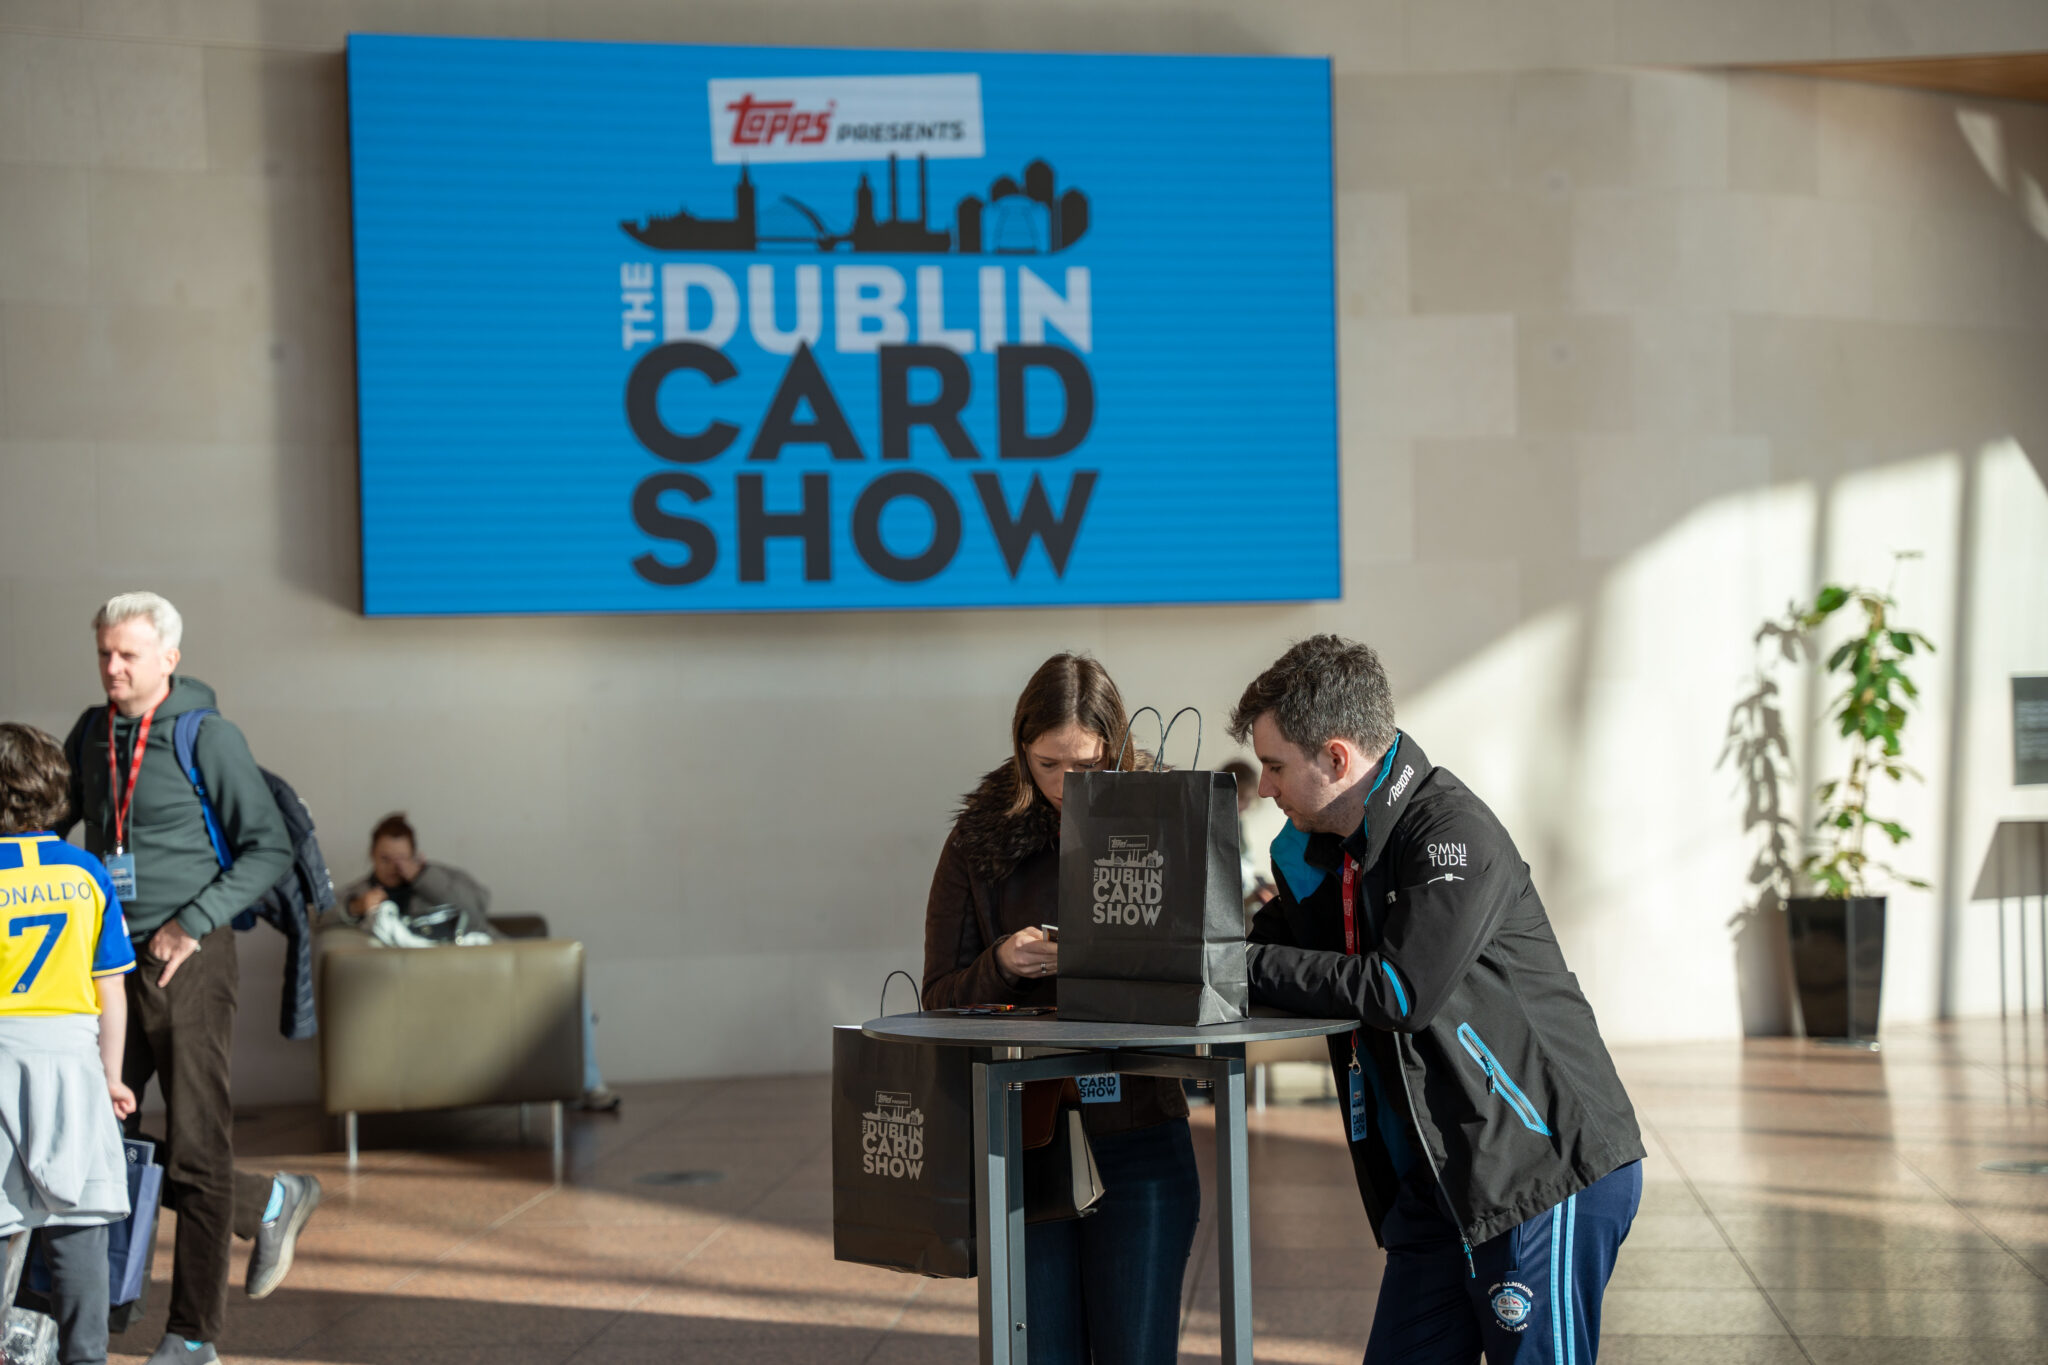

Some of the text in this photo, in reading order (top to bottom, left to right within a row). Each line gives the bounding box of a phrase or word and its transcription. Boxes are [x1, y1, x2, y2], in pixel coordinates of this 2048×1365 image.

[836, 120, 966, 144] PRESENTS
[620, 262, 1093, 355] THE DUBLIN
[625, 339, 1095, 463] CARD
[630, 470, 1100, 586] SHOW
[1390, 764, 1415, 802] Rexona
[1427, 843, 1467, 856] OMNI
[1429, 854, 1468, 867] TUDE
[1099, 867, 1163, 885] DUBLIN
[1093, 880, 1163, 905] CARD
[1092, 902, 1162, 926] SHOW
[9, 912, 69, 994] 7
[1078, 1076, 1116, 1087] CARD
[1079, 1087, 1116, 1098] SHOW
[867, 1120, 924, 1142] DUBLIN
[862, 1133, 924, 1160] CARD
[863, 1153, 924, 1180] SHOW
